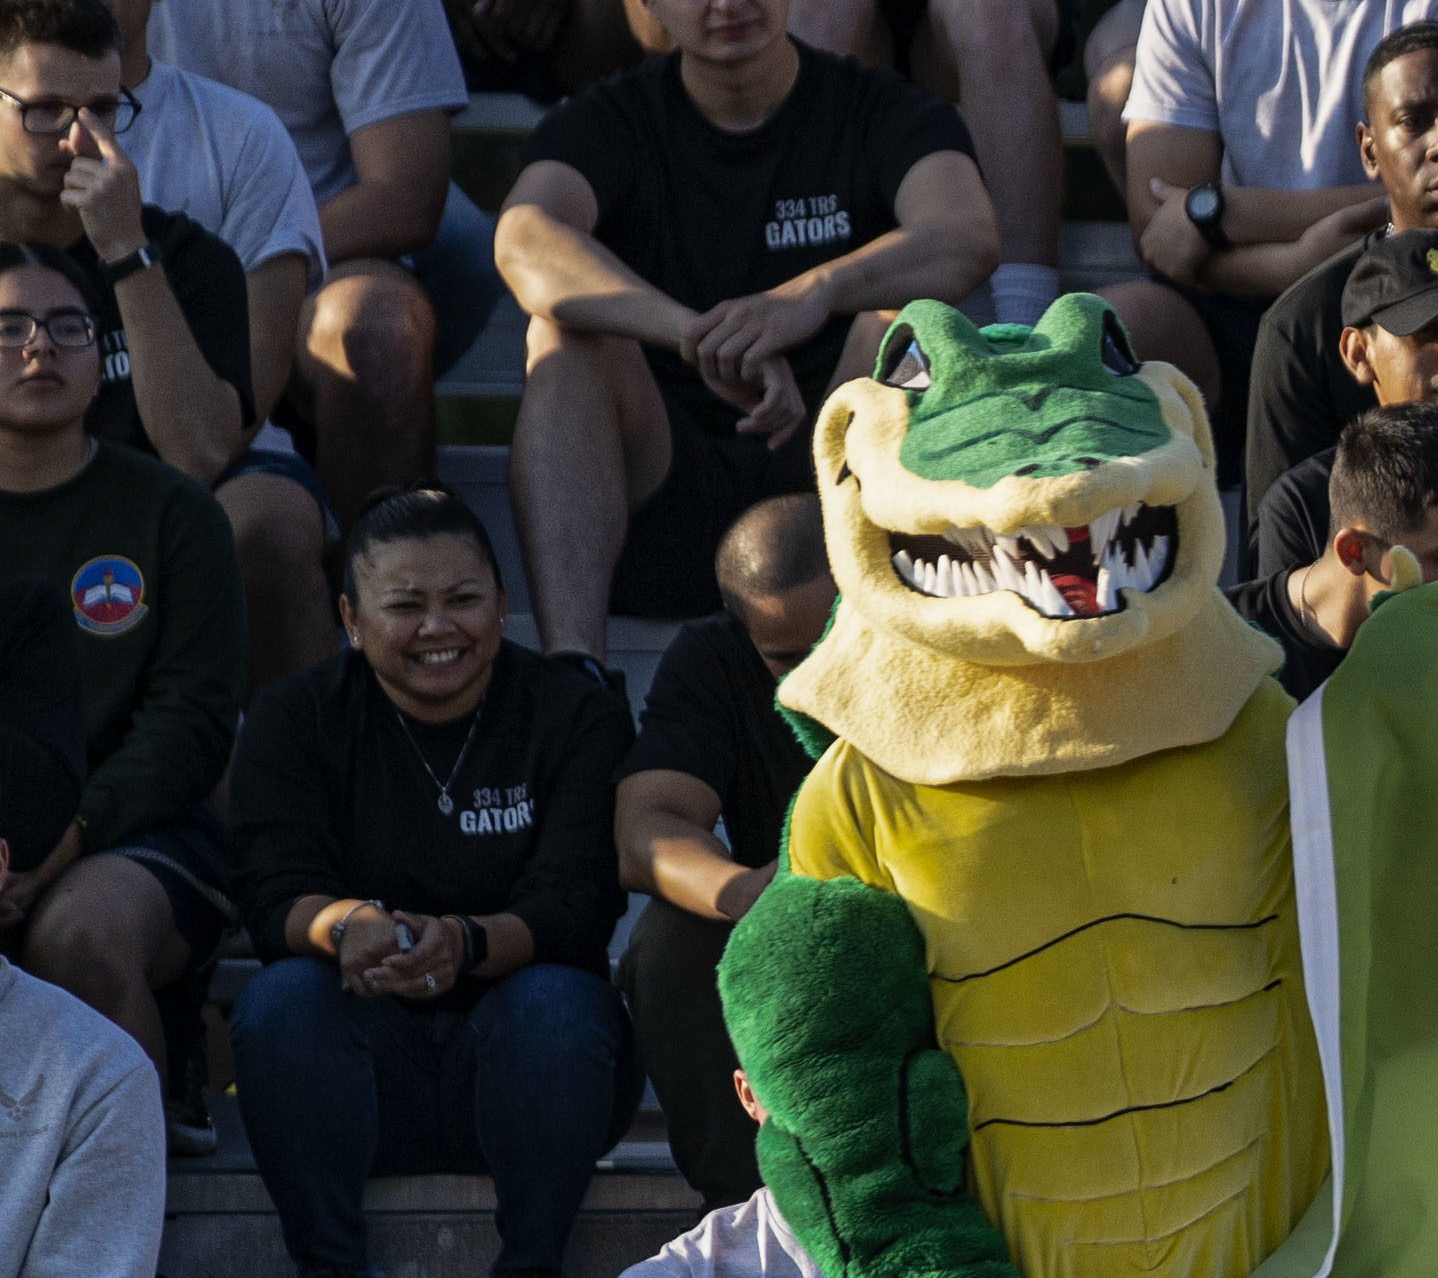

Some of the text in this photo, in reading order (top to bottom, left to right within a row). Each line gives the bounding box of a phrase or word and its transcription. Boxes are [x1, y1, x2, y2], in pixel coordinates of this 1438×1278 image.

[776, 194, 838, 220] 334 TRS
[765, 210, 851, 250] GATORS
[473, 786, 501, 809] 334
[460, 798, 534, 836] GATOR
